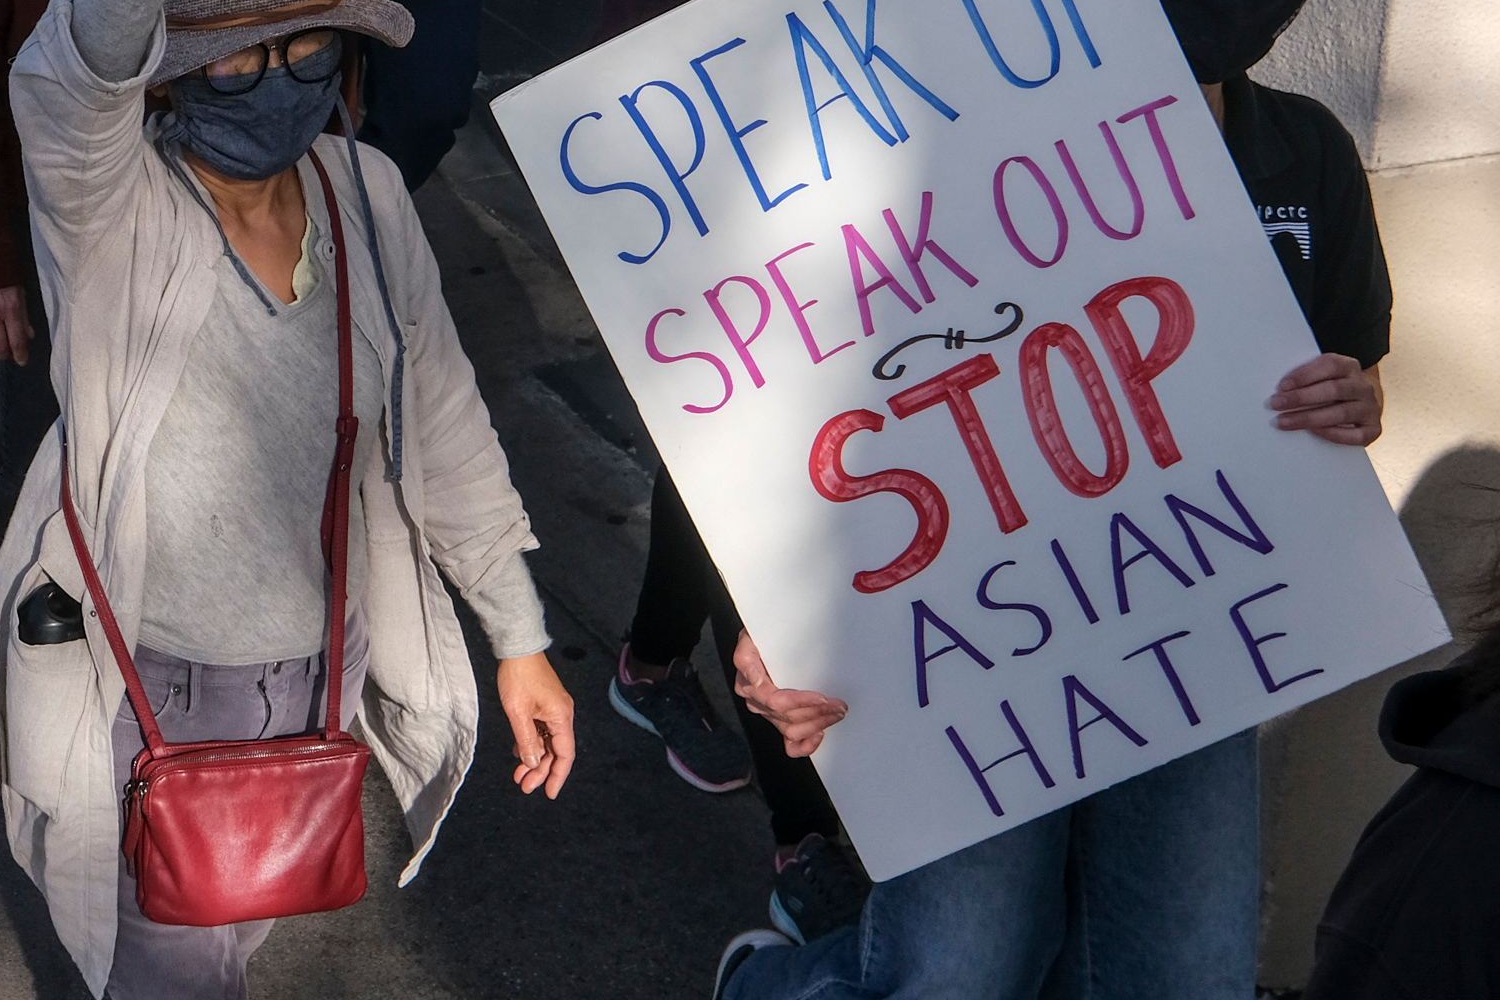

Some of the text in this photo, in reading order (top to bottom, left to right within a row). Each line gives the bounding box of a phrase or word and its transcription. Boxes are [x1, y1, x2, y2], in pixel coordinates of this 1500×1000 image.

[644, 95, 1196, 414] SPEAK OUT
[808, 276, 1195, 594] STOP
[910, 469, 1275, 708] ASIAN
[945, 583, 1324, 817] HATE
